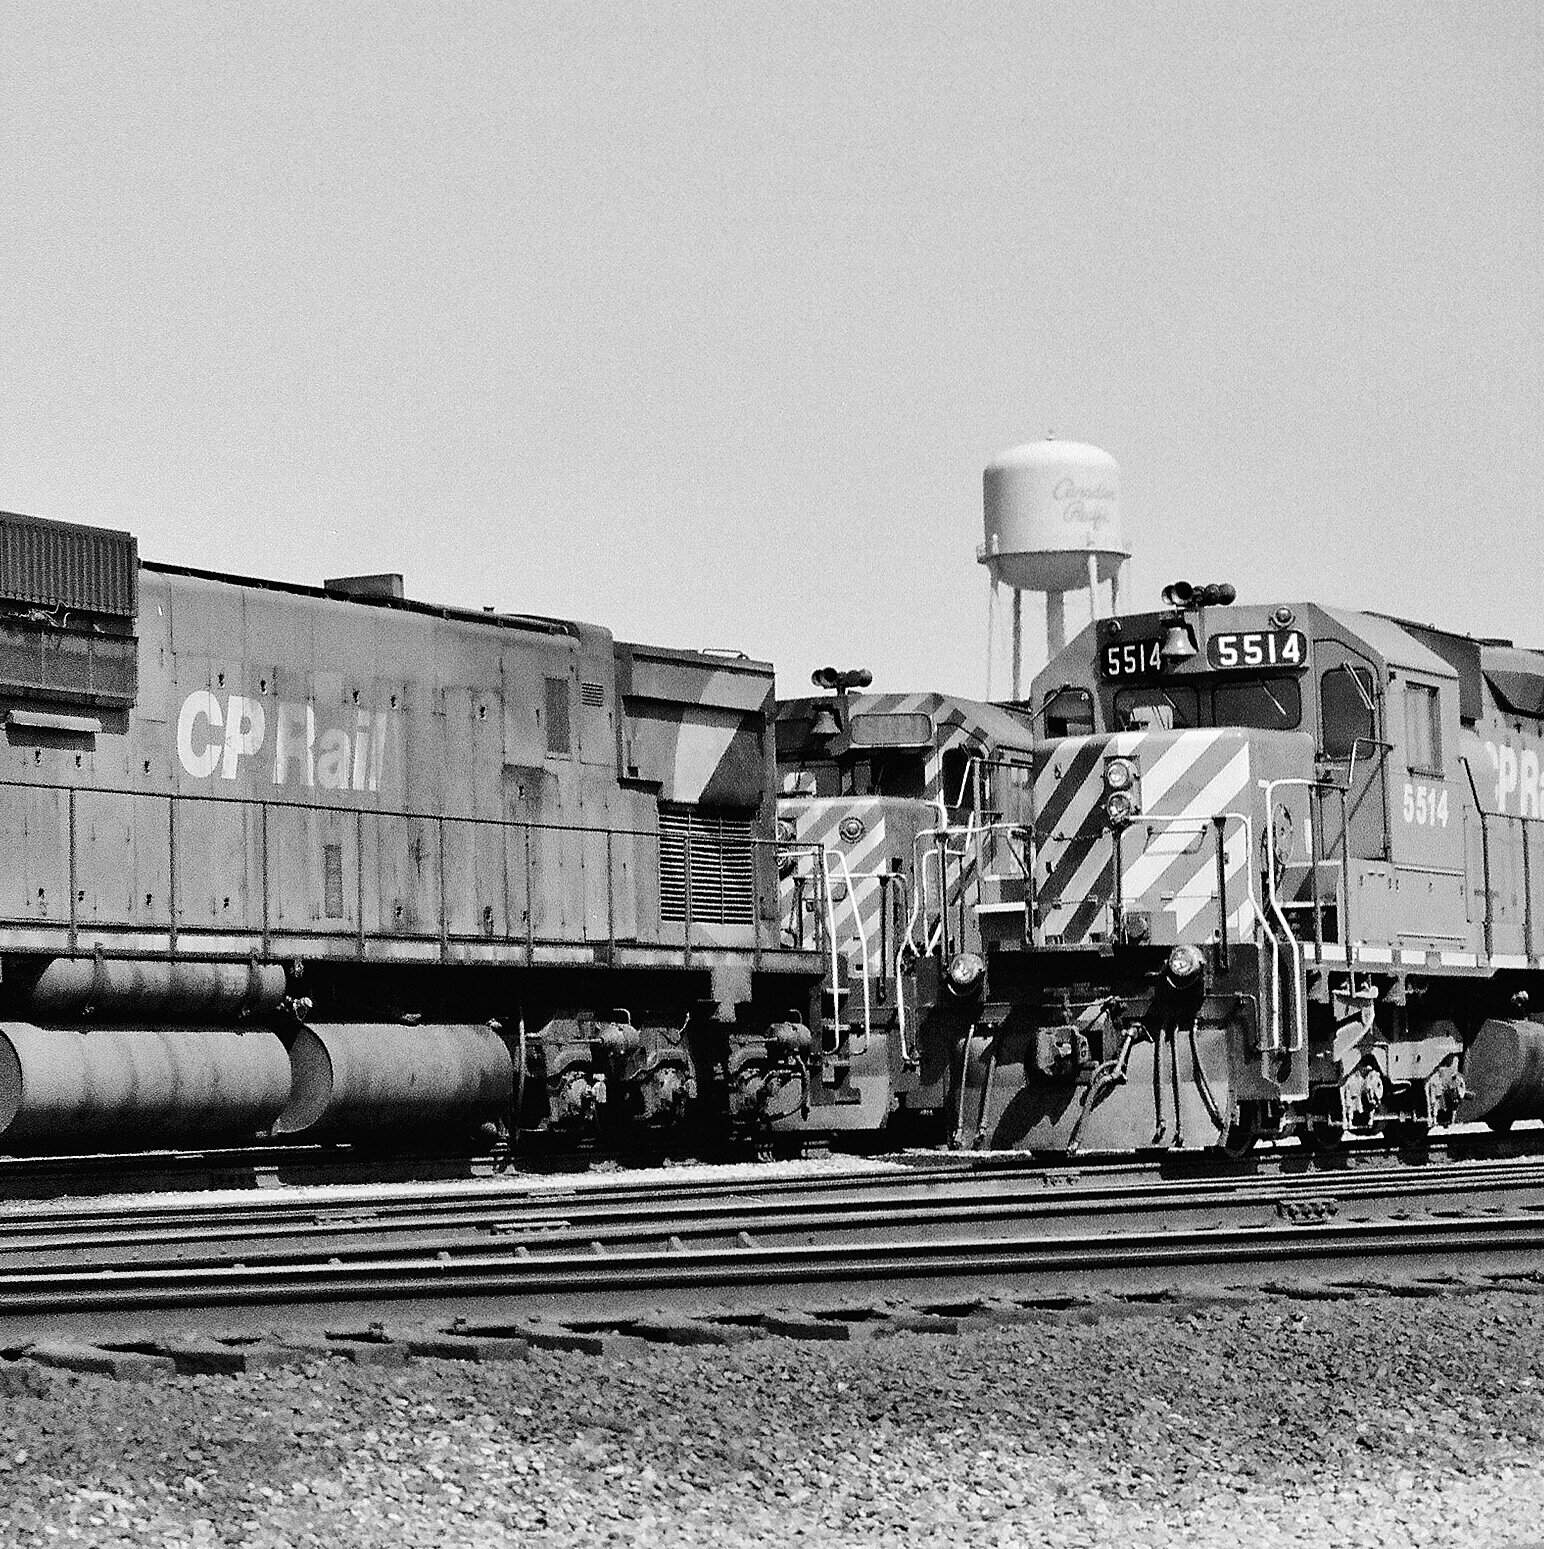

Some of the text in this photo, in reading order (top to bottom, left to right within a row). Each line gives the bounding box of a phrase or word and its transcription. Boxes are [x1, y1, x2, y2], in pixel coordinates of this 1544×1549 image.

[1108, 642, 1161, 676] 5514
[1217, 633, 1301, 666] 5514
[177, 690, 388, 792] CP Rail
[1403, 783, 1449, 828] 5514
[1521, 749, 1544, 819] R
